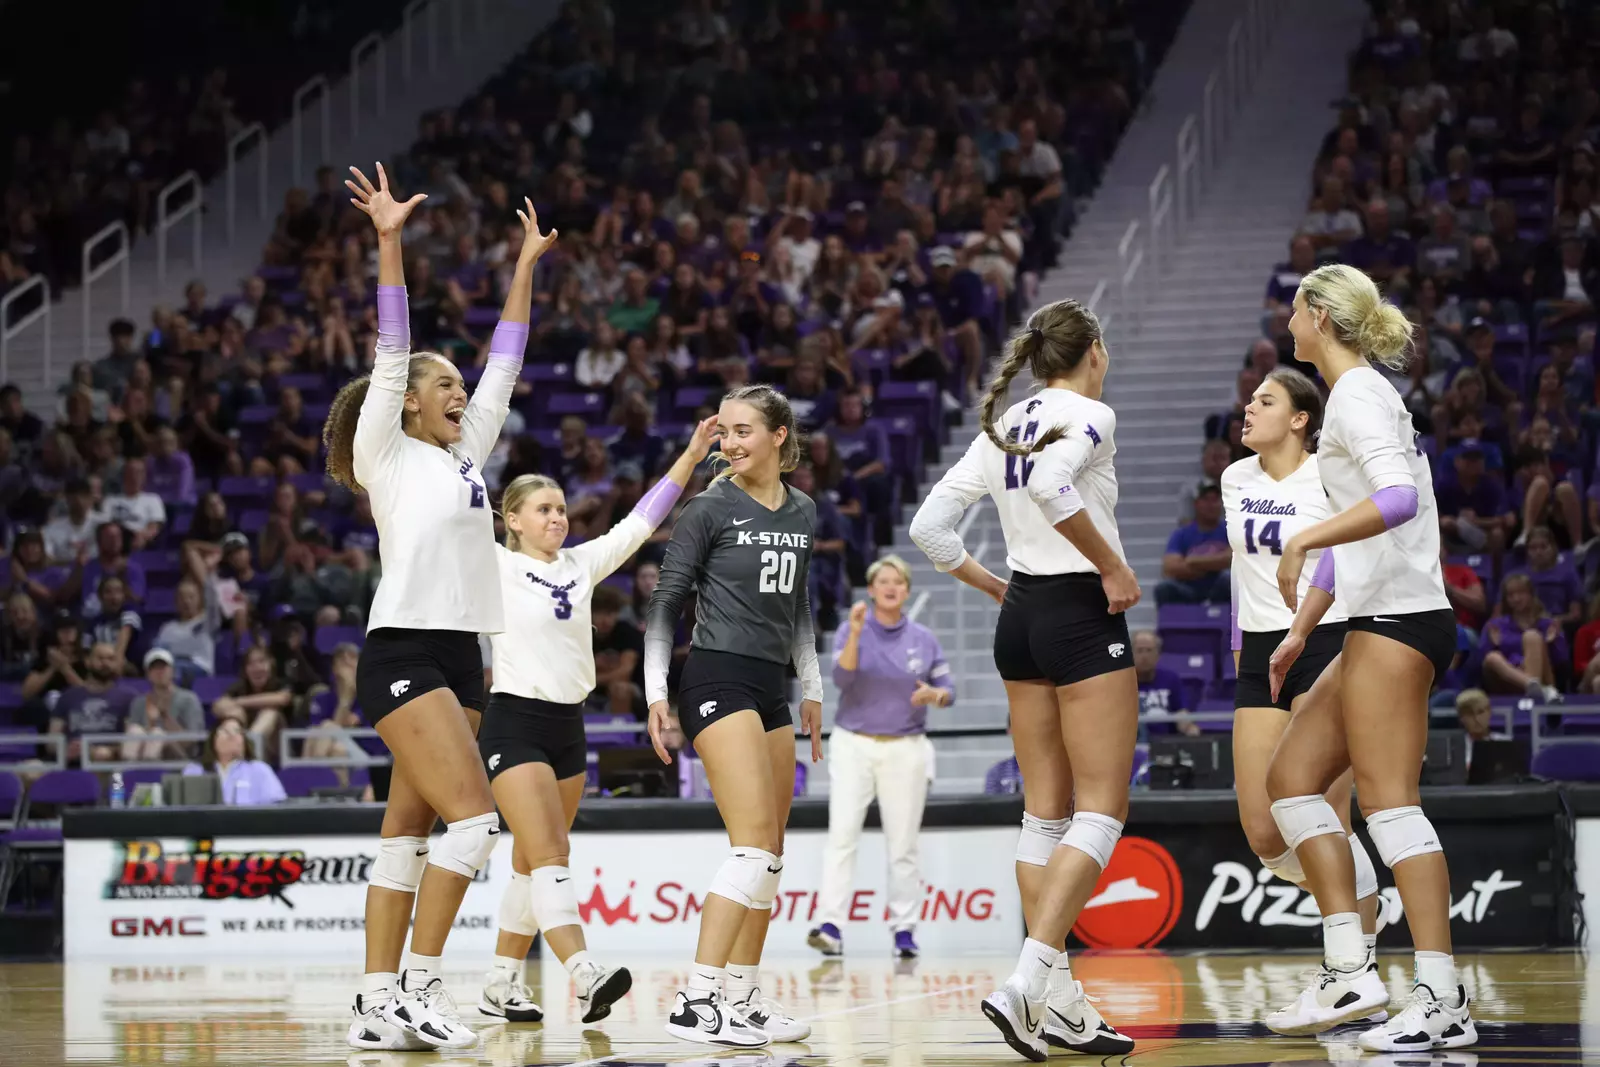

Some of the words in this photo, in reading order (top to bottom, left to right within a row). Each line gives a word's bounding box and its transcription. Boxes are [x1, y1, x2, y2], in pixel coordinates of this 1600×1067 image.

[1240, 497, 1297, 516] Wildcats
[736, 531, 808, 549] K-STATE
[1243, 518, 1283, 556] 14
[759, 550, 797, 594] 20
[551, 590, 573, 620] 3
[119, 839, 304, 899] Briggs
[116, 884, 153, 898] AUTO
[154, 884, 203, 898] GROUP
[111, 917, 206, 936] GMC
[221, 918, 250, 932] WE
[254, 918, 285, 931] ARE
